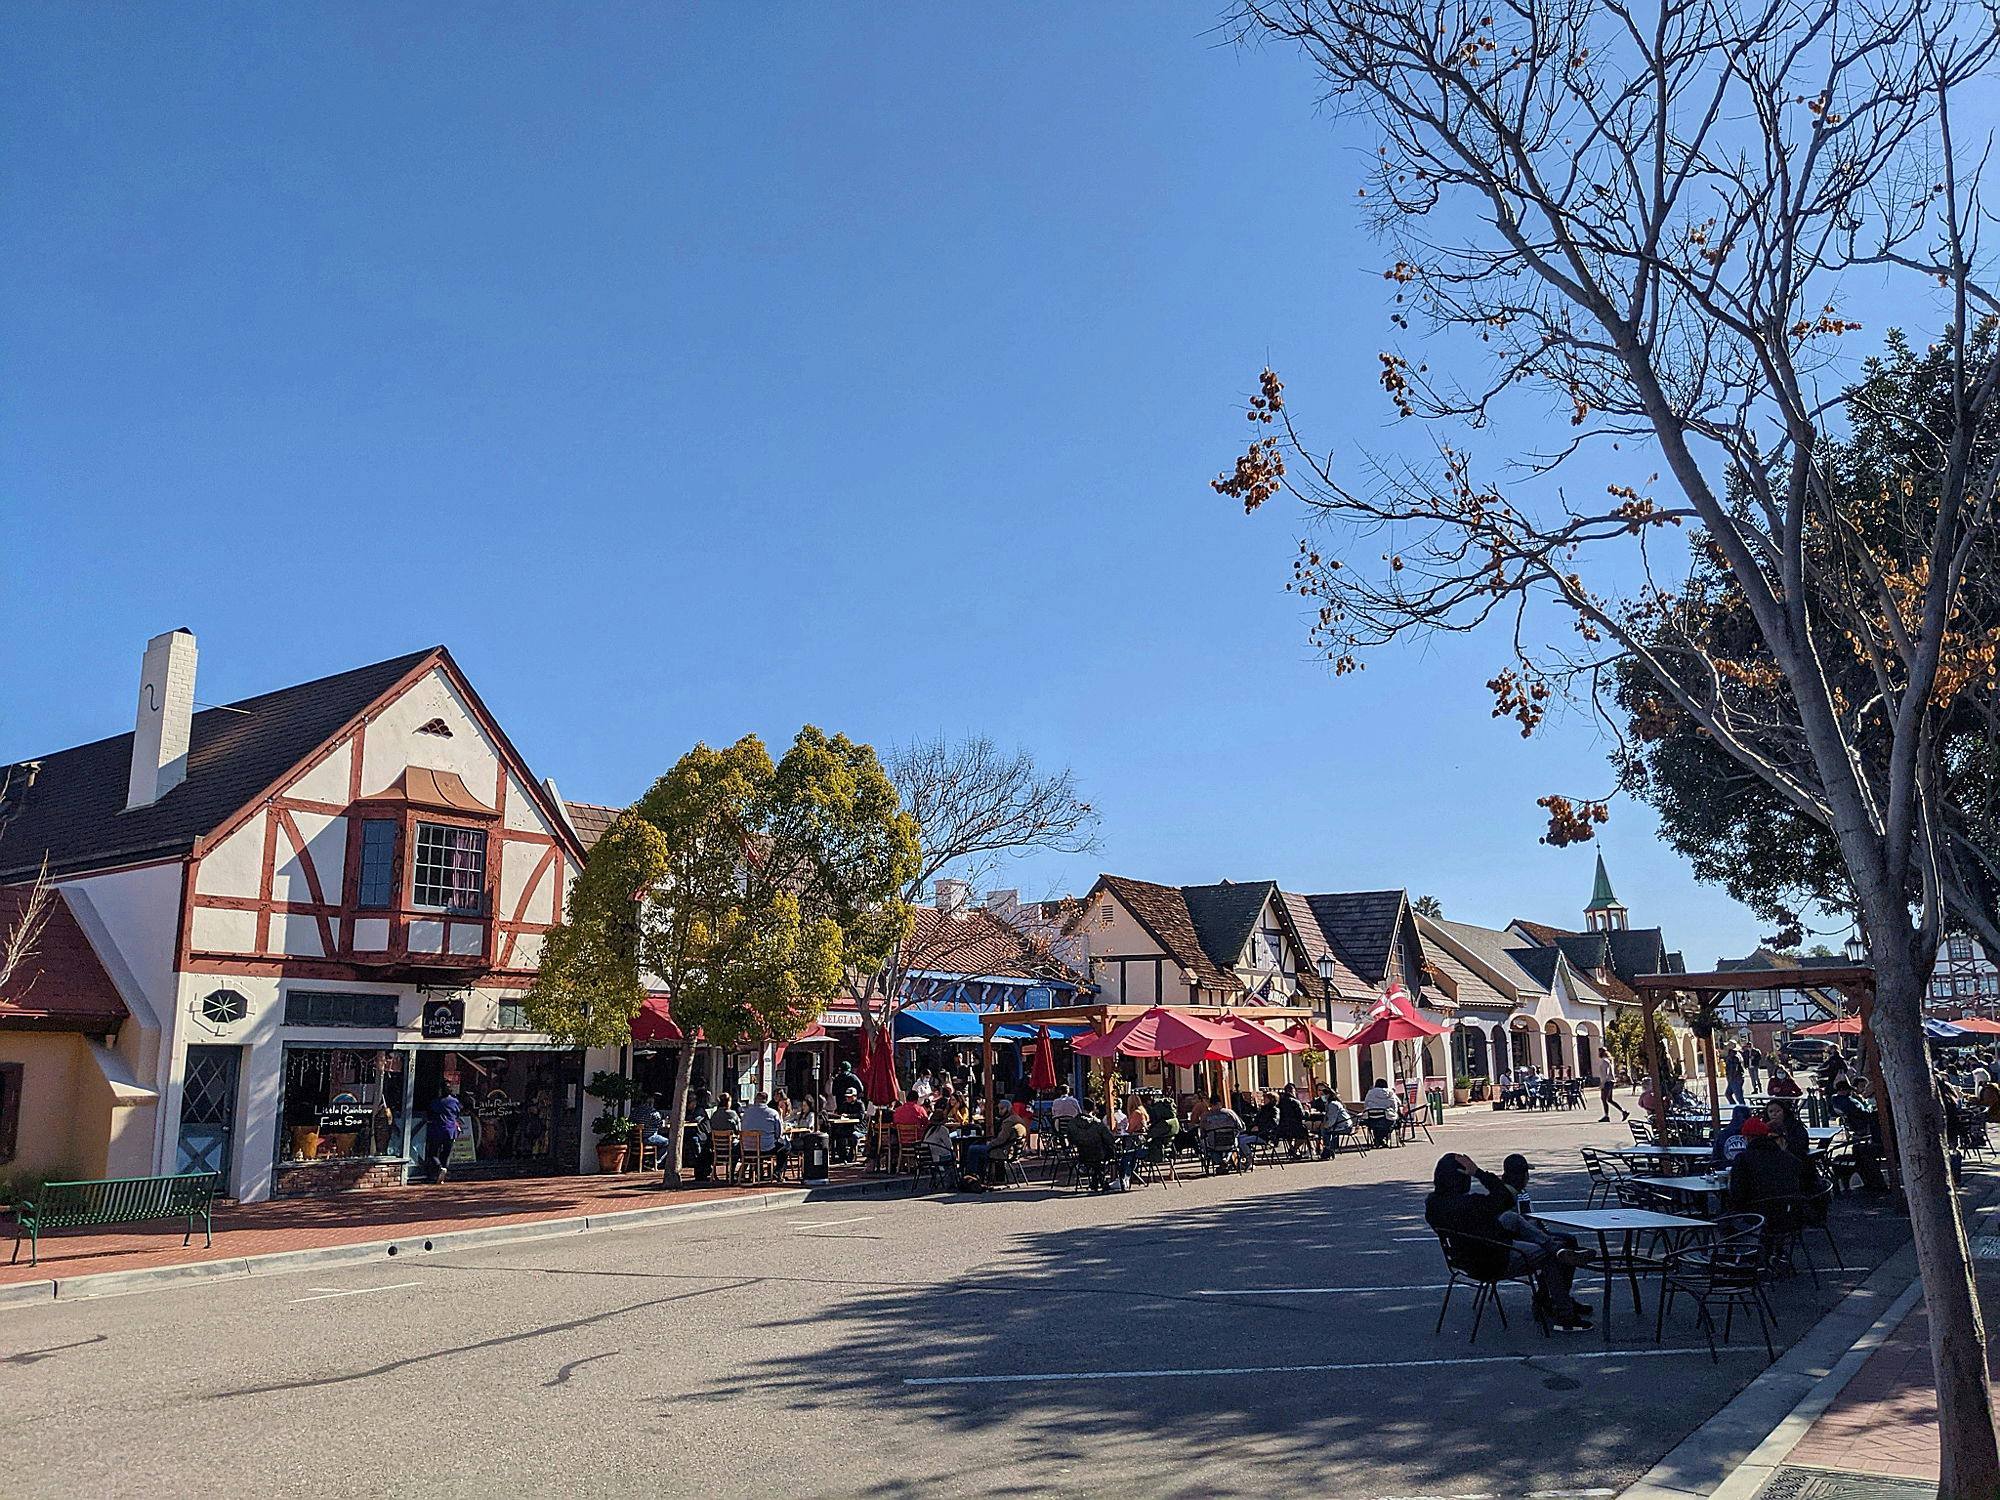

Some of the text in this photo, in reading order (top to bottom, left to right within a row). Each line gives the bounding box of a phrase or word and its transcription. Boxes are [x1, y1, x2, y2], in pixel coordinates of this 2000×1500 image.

[822, 1014, 861, 1025] BELGIAN
[314, 1104, 373, 1115] Little Rainbow
[498, 1106, 512, 1116] Spa
[320, 1115, 362, 1128] Foot Spa
